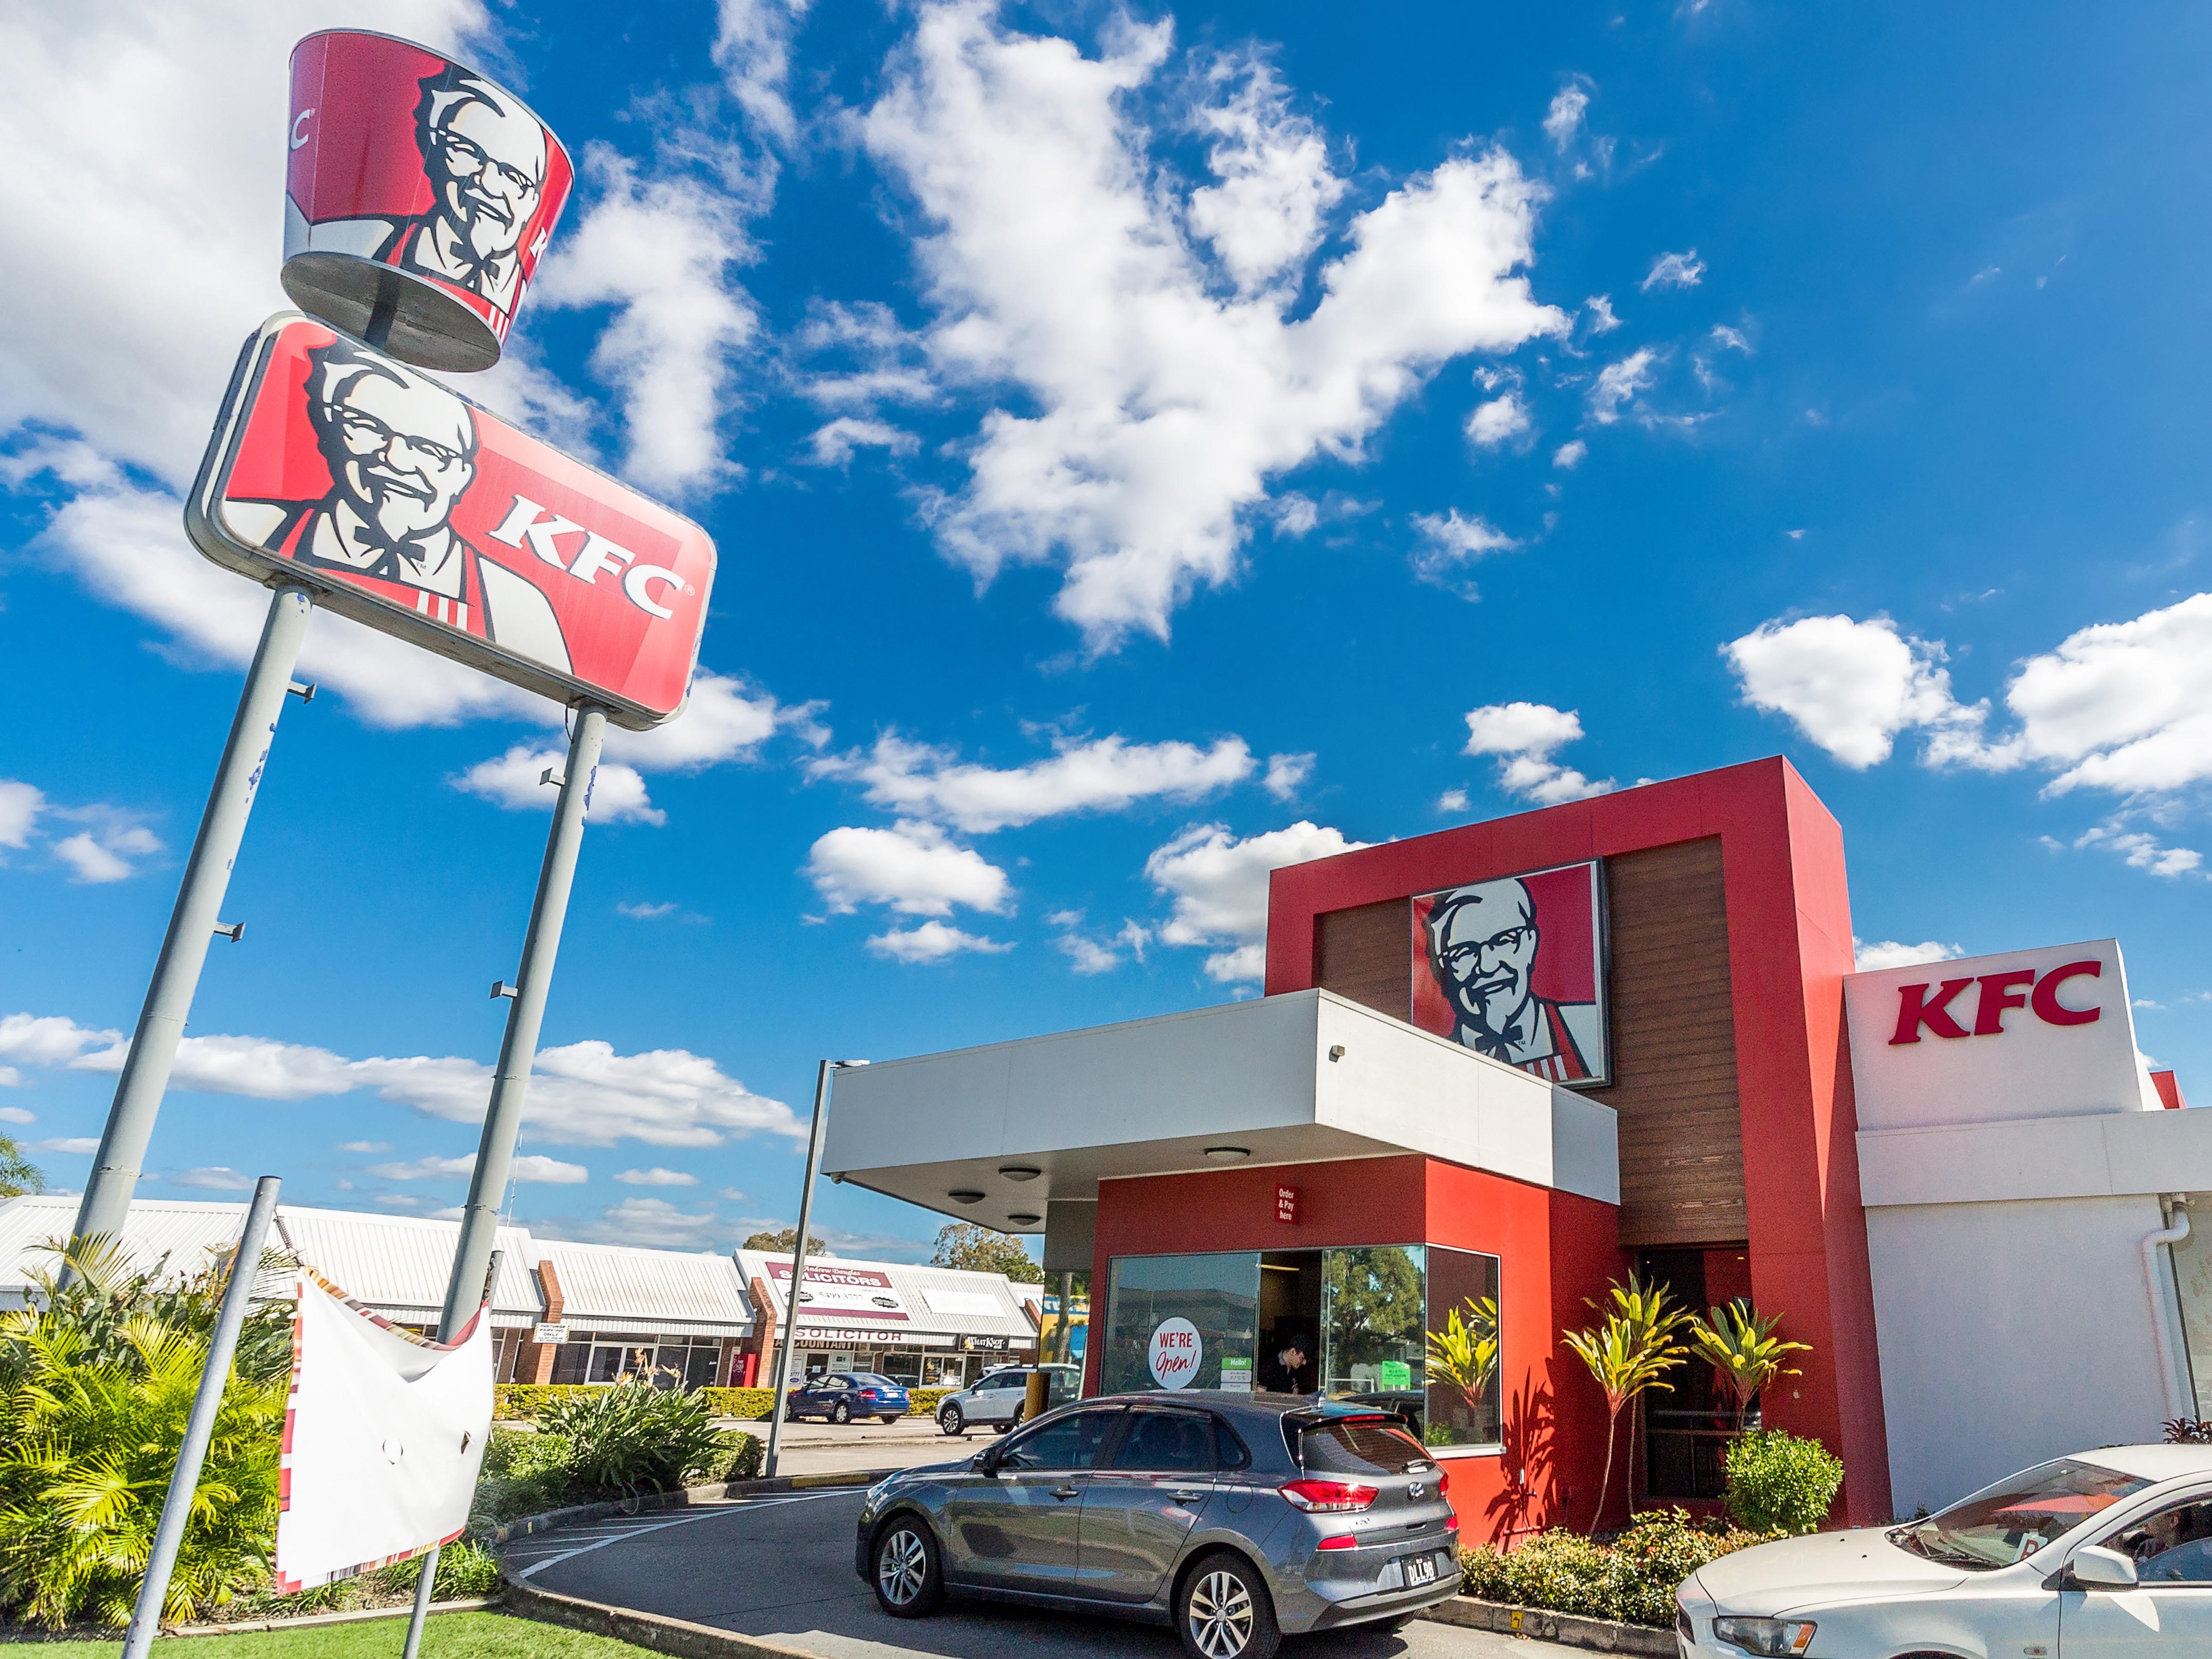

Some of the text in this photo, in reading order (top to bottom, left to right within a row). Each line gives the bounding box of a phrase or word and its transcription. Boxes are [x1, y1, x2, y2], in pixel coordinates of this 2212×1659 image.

[485, 493, 686, 620] KFC
[1888, 960, 2102, 1046] KFC
[1279, 1188, 1294, 1199] Order
[1278, 1199, 1294, 1211] & Pay
[1280, 1210, 1292, 1220] here
[779, 1270, 881, 1287] SLICITORS
[794, 1328, 902, 1341] SOLICITOR
[1160, 1331, 1193, 1347] WE'RE
[775, 1339, 851, 1350] ACOUNTANT
[1156, 1350, 1197, 1380] Open!
[2020, 1539, 2039, 1559] P
